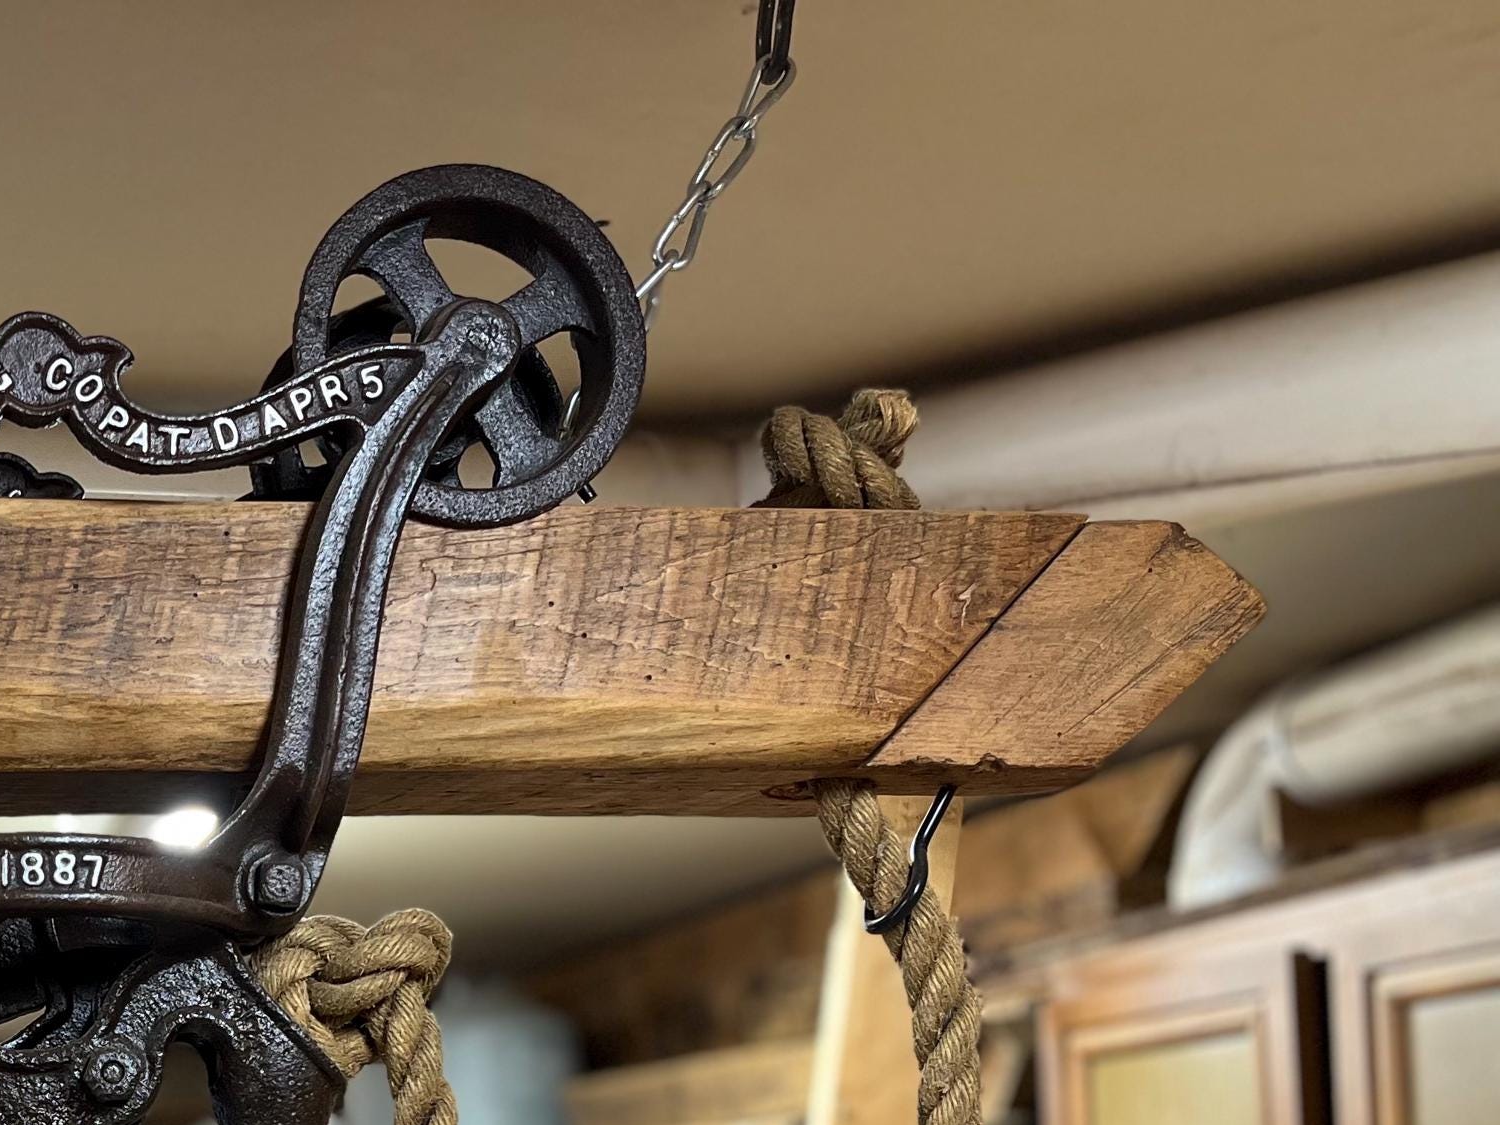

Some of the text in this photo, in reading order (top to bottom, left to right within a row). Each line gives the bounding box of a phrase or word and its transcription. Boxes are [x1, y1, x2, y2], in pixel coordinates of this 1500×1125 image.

[46, 358, 103, 402] CO
[98, 405, 190, 455] PAT
[262, 374, 348, 435] APR
[359, 365, 383, 398] 5
[1, 851, 103, 888] 1887
